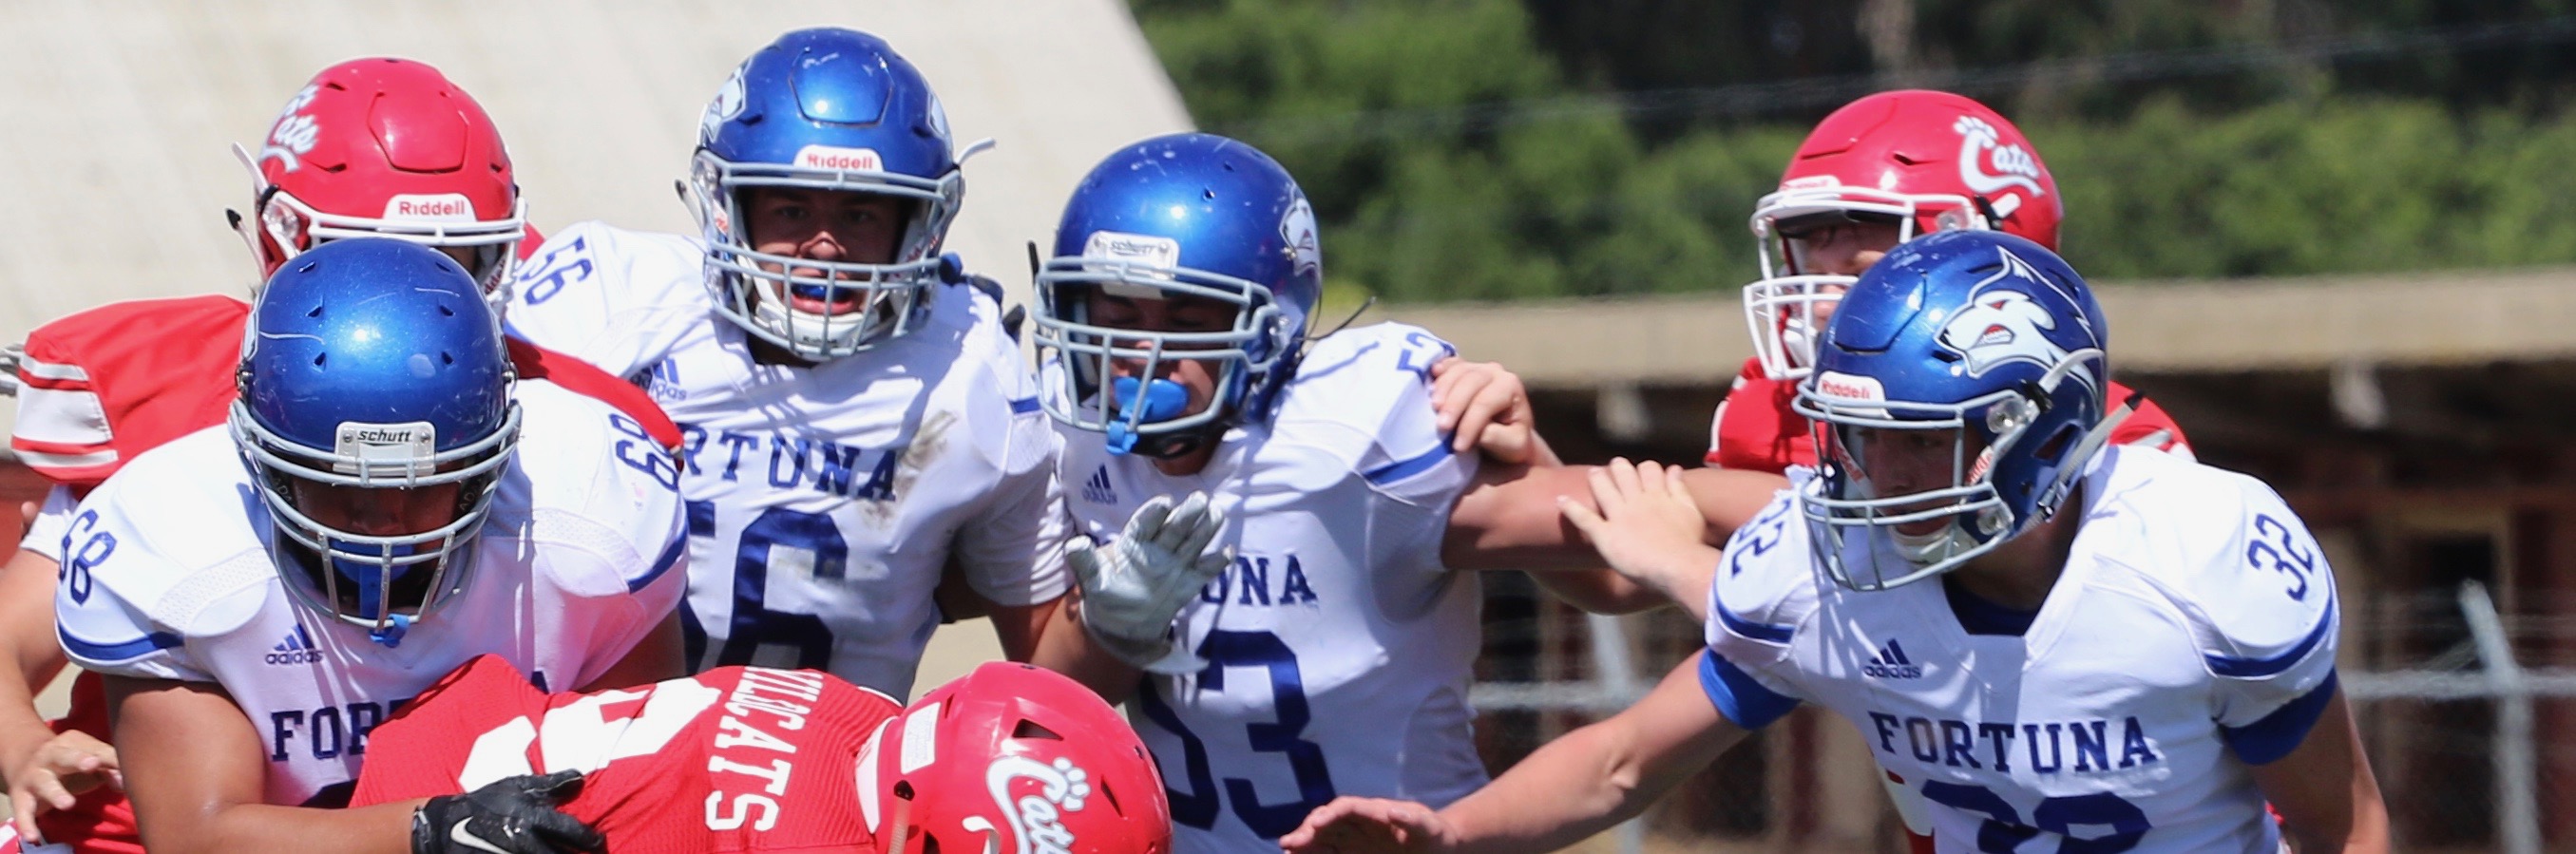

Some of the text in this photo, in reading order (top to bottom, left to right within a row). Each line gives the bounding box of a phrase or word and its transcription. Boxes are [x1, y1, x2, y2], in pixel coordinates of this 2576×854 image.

[808, 153, 873, 169] Riddell
[399, 200, 465, 216] Riddell
[520, 236, 592, 306] 56
[357, 428, 412, 444] schutt
[677, 422, 897, 503] RTUNA
[60, 508, 117, 606] 68
[2246, 513, 2314, 602] 32
[264, 647, 324, 665] adidas
[1863, 665, 1922, 679] adidas
[1867, 711, 2158, 774] FORTUNA
[985, 756, 1076, 854] Cat
